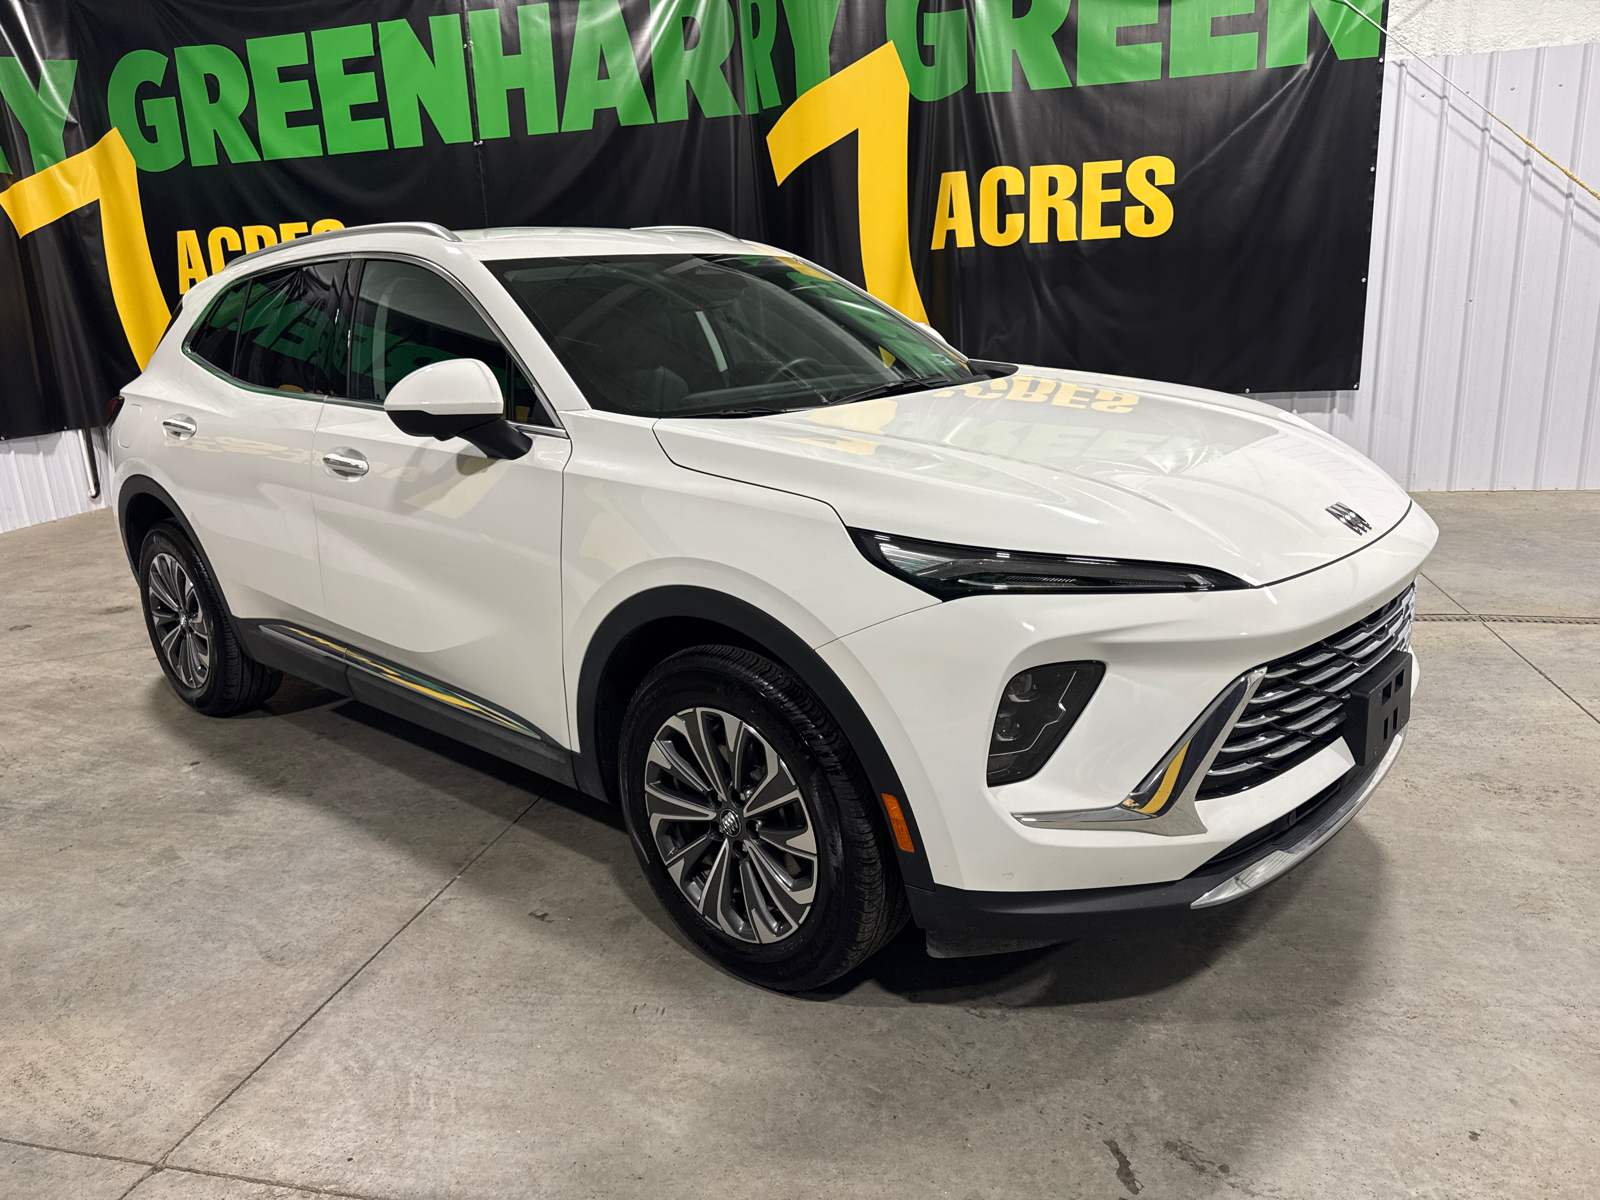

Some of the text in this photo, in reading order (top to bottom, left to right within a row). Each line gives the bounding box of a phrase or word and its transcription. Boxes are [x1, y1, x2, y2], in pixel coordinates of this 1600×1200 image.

[107, 14, 474, 172] GREEN
[467, 0, 1382, 140] HARRY GREEN
[931, 155, 1175, 251] ACRES
